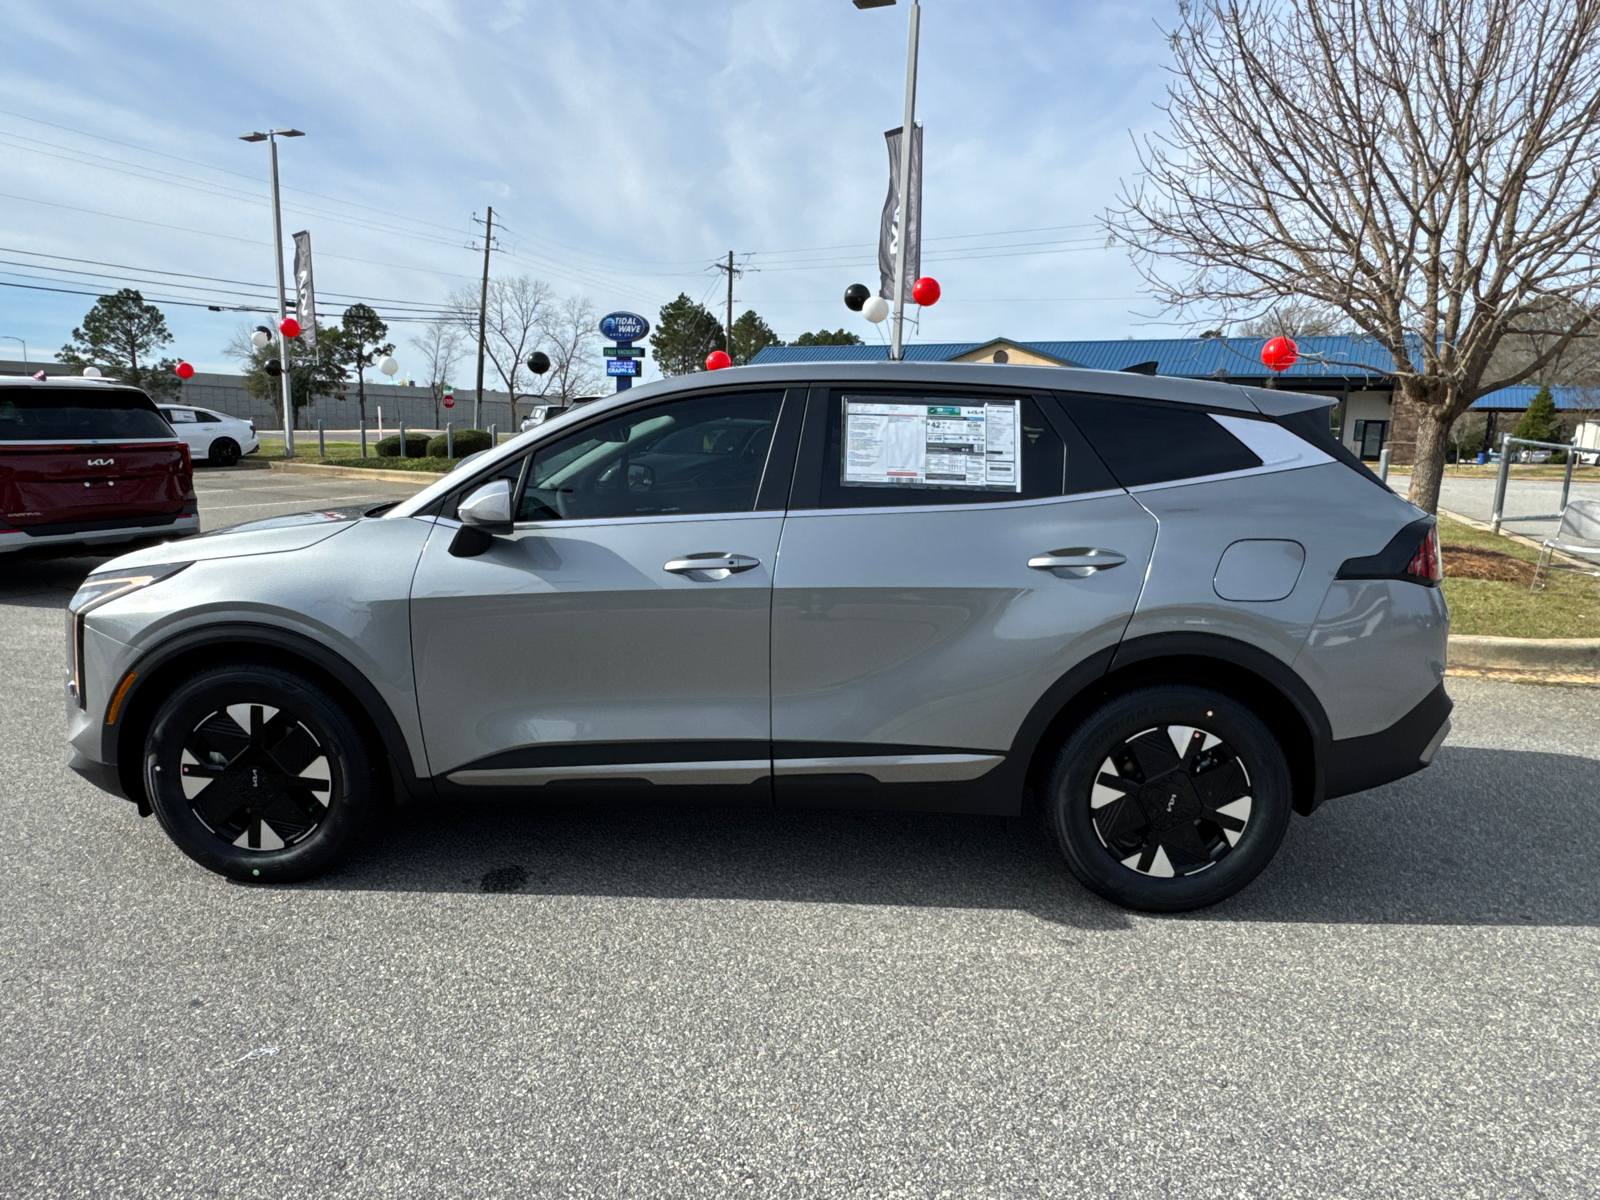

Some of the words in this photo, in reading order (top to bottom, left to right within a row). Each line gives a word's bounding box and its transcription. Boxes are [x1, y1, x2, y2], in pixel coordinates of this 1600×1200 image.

[615, 317, 637, 325] TIDAL
[618, 325, 642, 333] WAVE
[931, 421, 941, 429] 42
[87, 458, 115, 466] KIA
[1166, 793, 1177, 812] KIA
